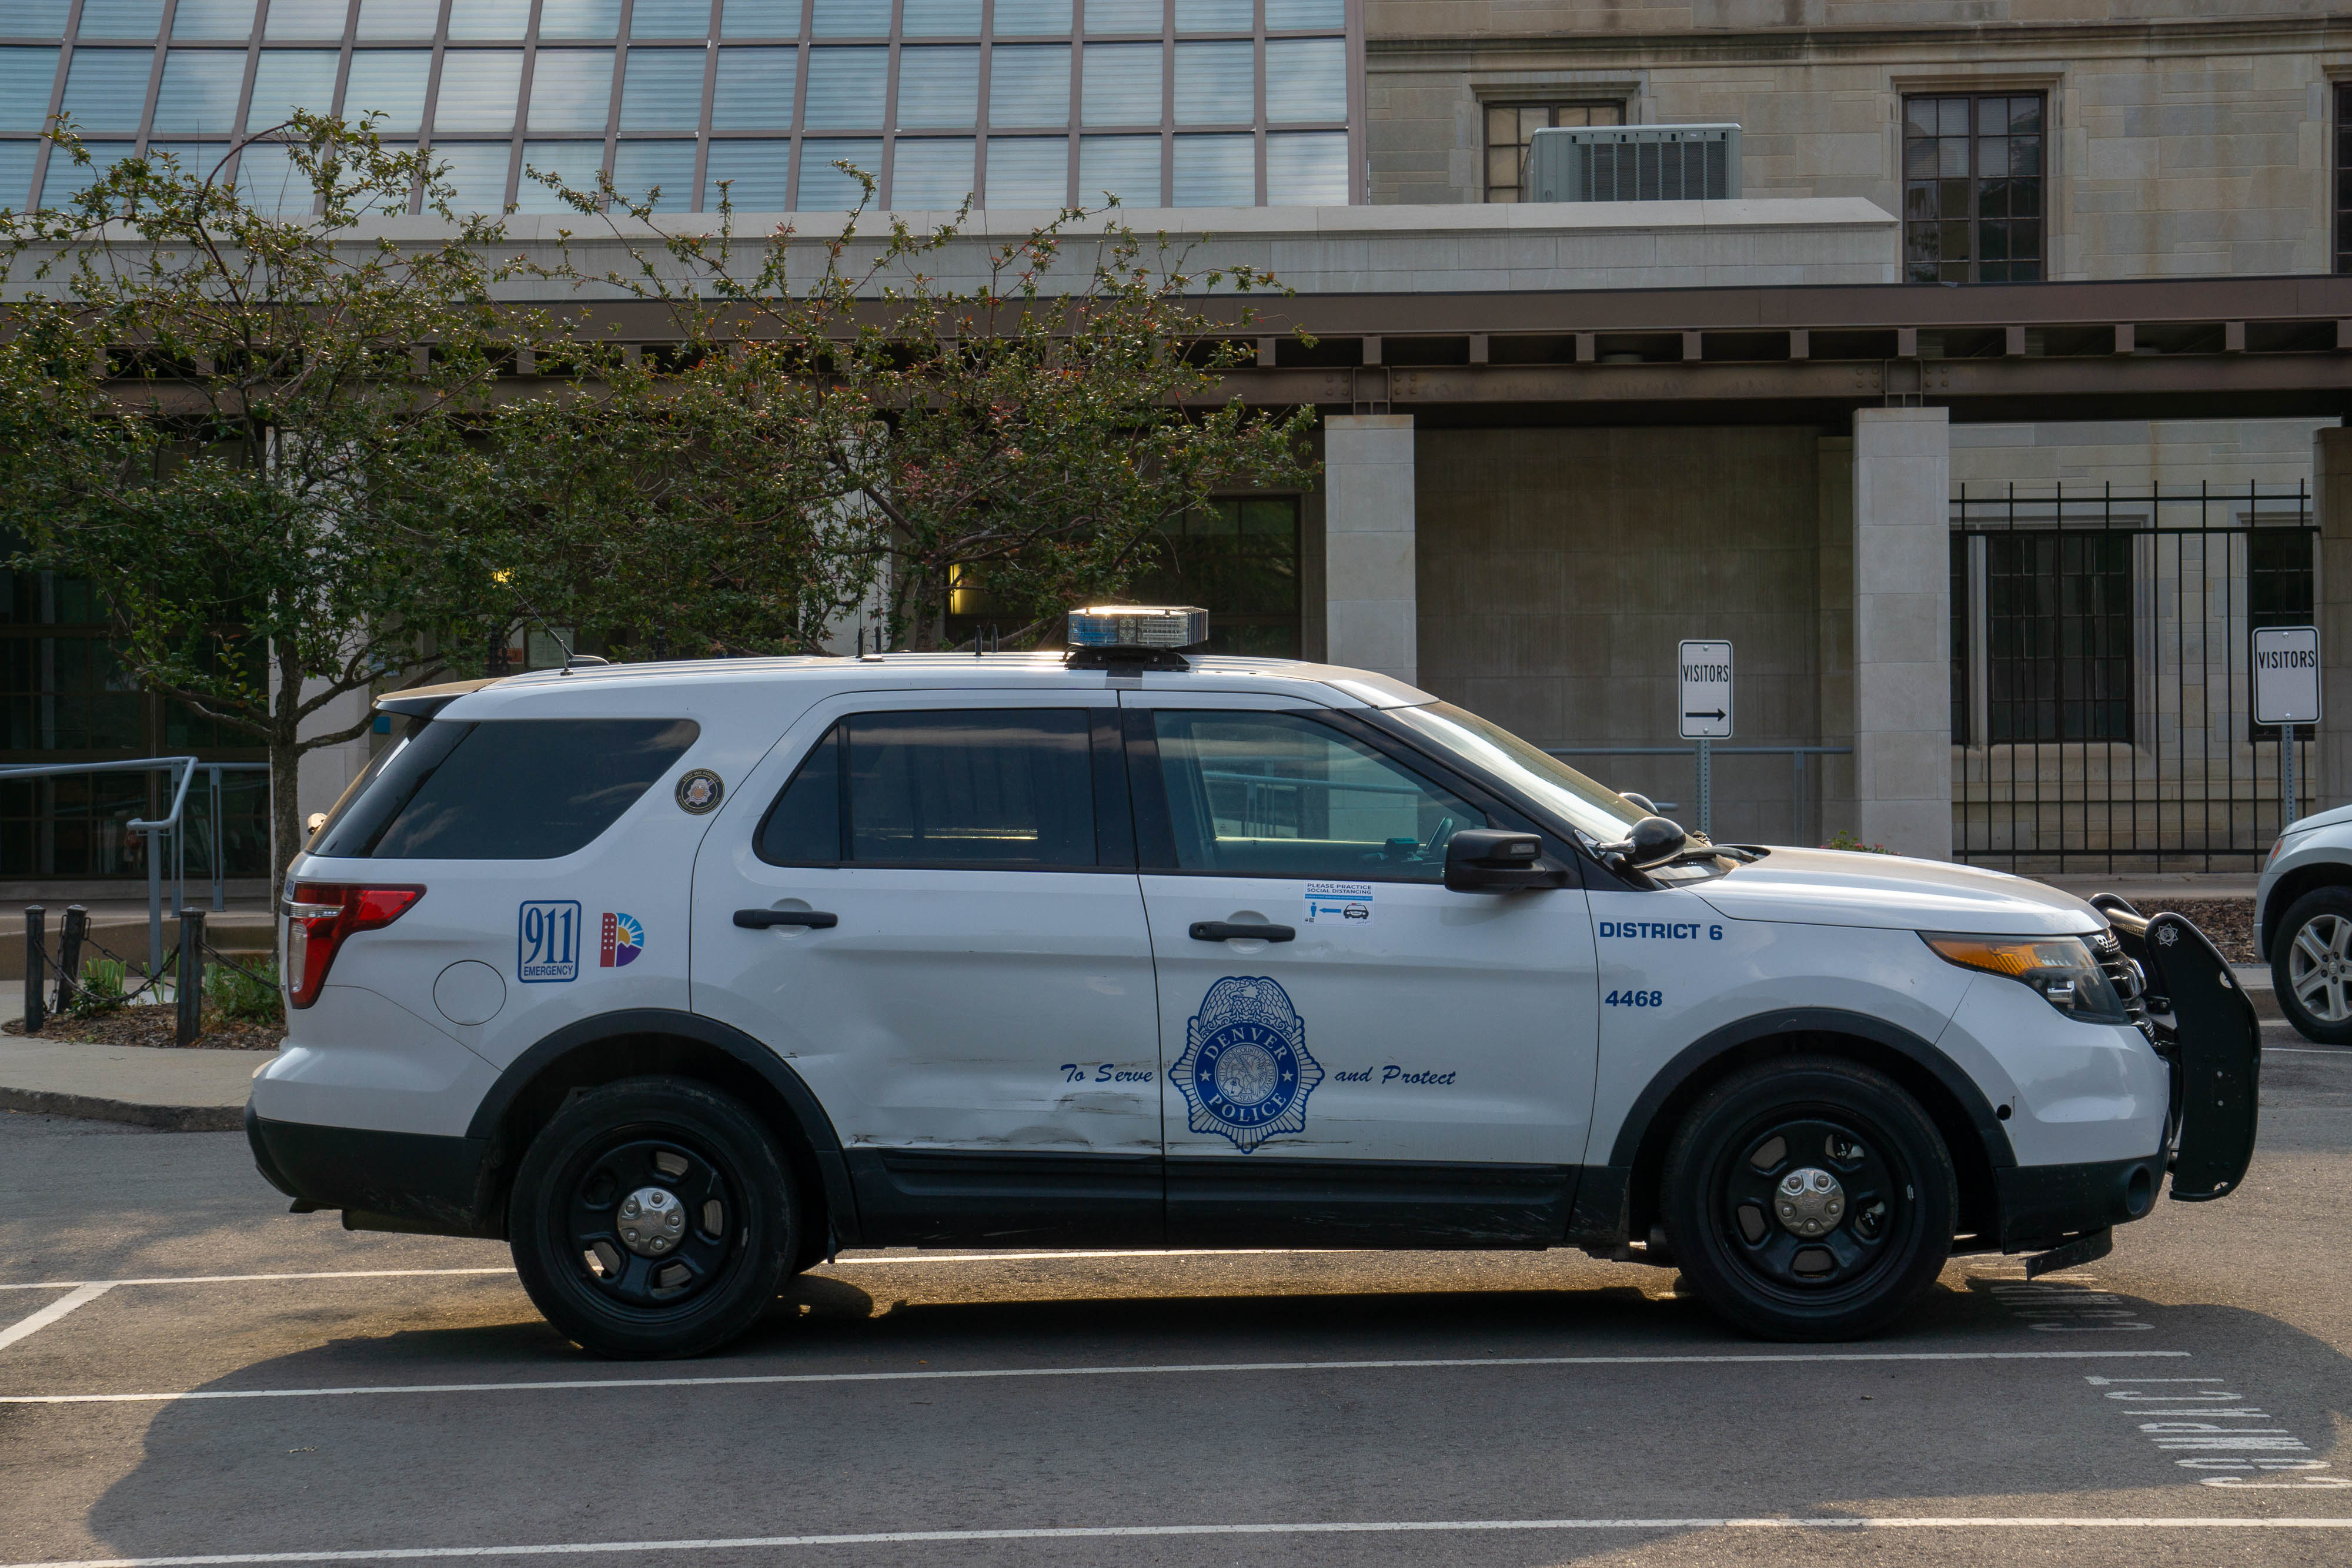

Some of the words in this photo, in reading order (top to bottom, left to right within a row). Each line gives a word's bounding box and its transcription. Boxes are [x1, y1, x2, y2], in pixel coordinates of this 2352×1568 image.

[2258, 650, 2315, 668] VISITORS
[1683, 664, 1729, 682] VISITORS
[683, 773, 694, 782] LEST
[524, 907, 573, 964] 911
[1600, 922, 1700, 939] DISTRICT
[1709, 925, 1723, 941] 6
[524, 965, 573, 976] EMERGENCY
[1605, 990, 1663, 1007] 4468
[1205, 1027, 1288, 1061] DENVER
[1061, 1064, 1086, 1083] To
[1095, 1064, 1154, 1083] Serve
[1335, 1066, 1374, 1083] and
[1382, 1065, 1458, 1085] Protect
[1208, 1092, 1287, 1122] POLICE
[2083, 1375, 2352, 1489] COMPACT
